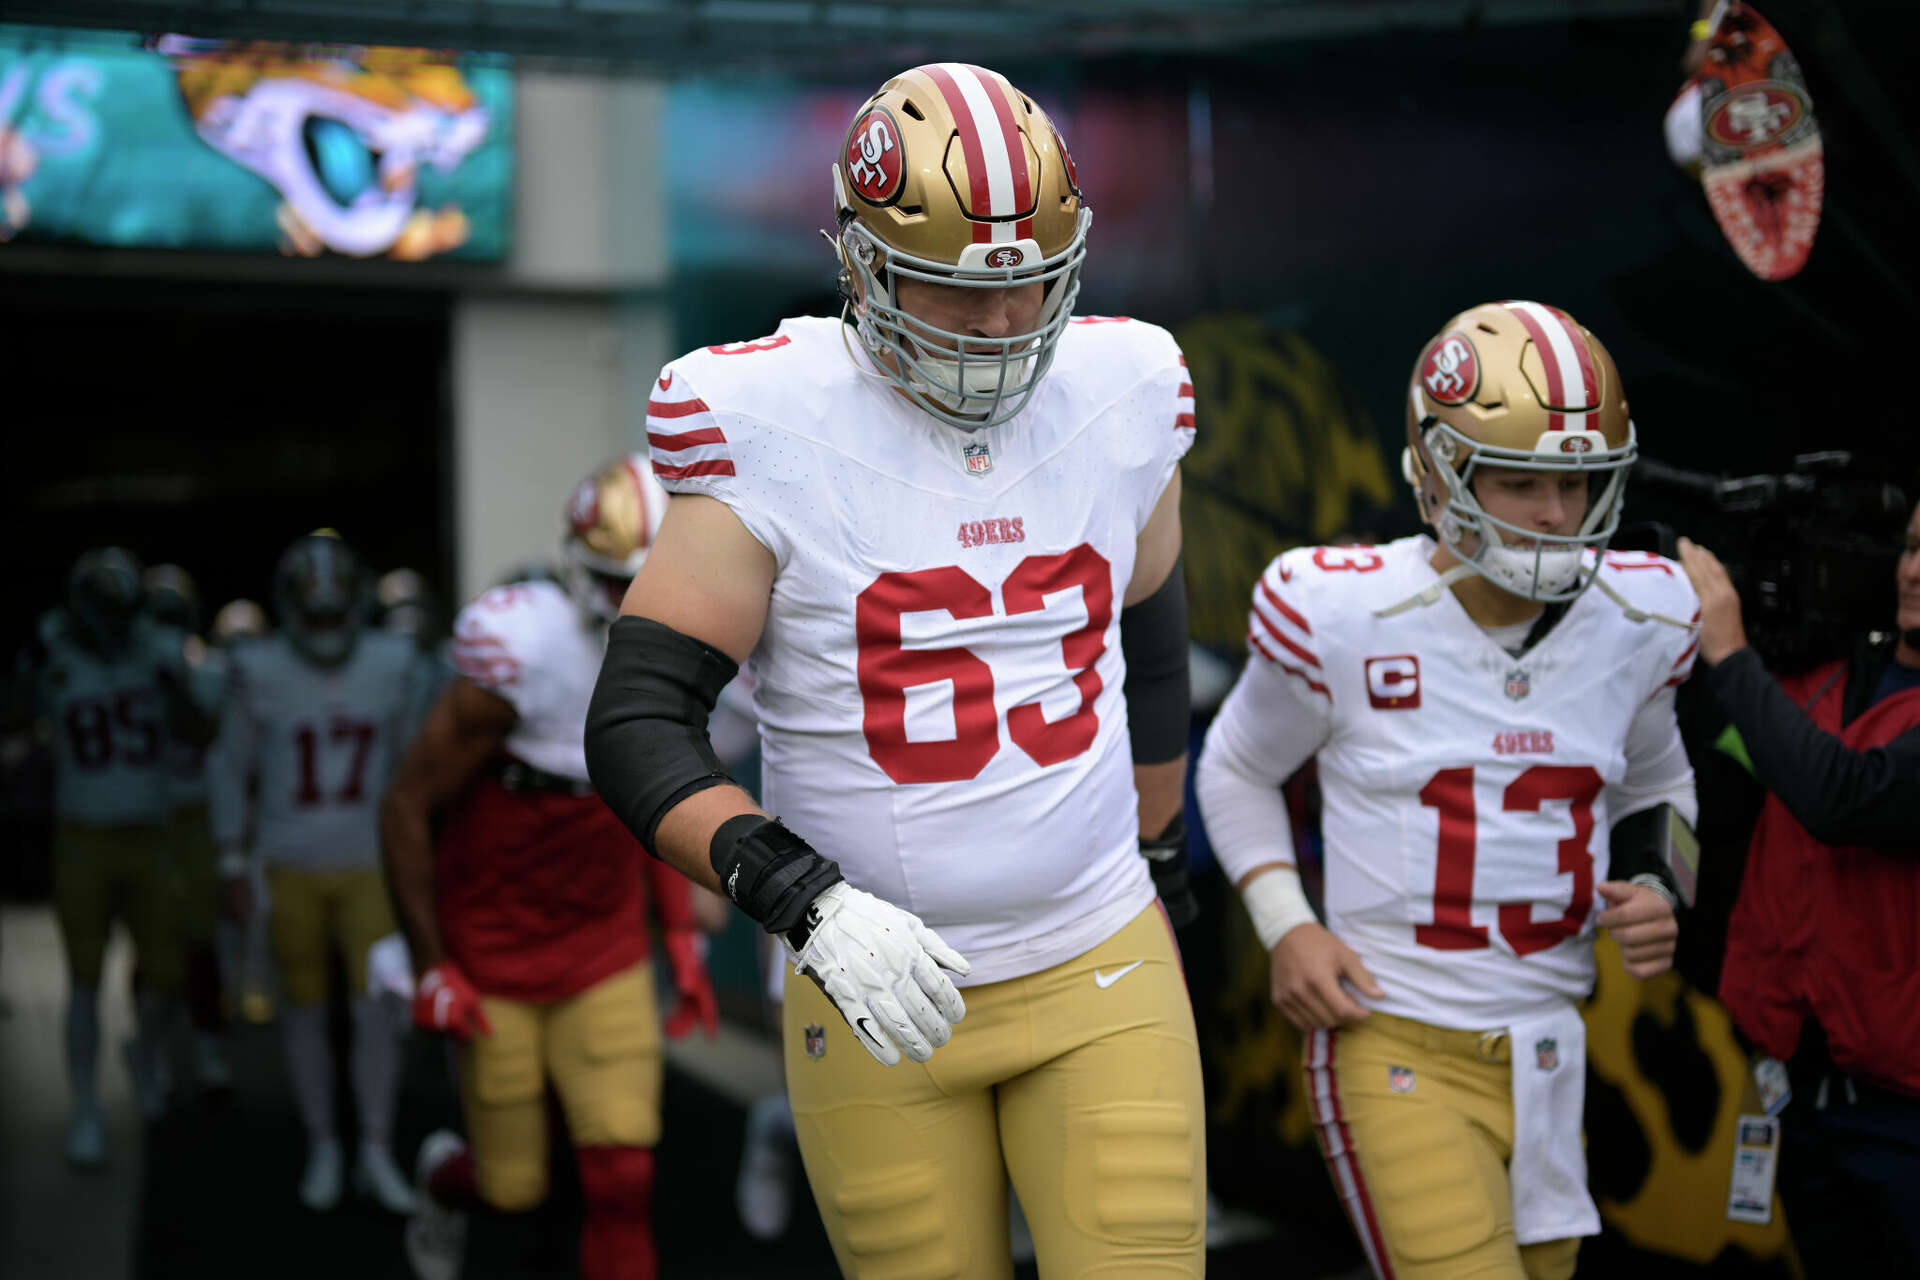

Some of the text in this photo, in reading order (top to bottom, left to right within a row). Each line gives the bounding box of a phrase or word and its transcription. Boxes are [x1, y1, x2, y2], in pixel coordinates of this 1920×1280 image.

[849, 120, 895, 189] SF
[967, 455, 990, 471] NFL
[957, 516, 1026, 549] 49ERS
[855, 542, 1113, 785] 63
[1368, 658, 1418, 698] C
[65, 687, 160, 773] 85
[293, 715, 377, 804] 17
[1492, 730, 1555, 755] 49ERS
[1415, 765, 1606, 957] 13
